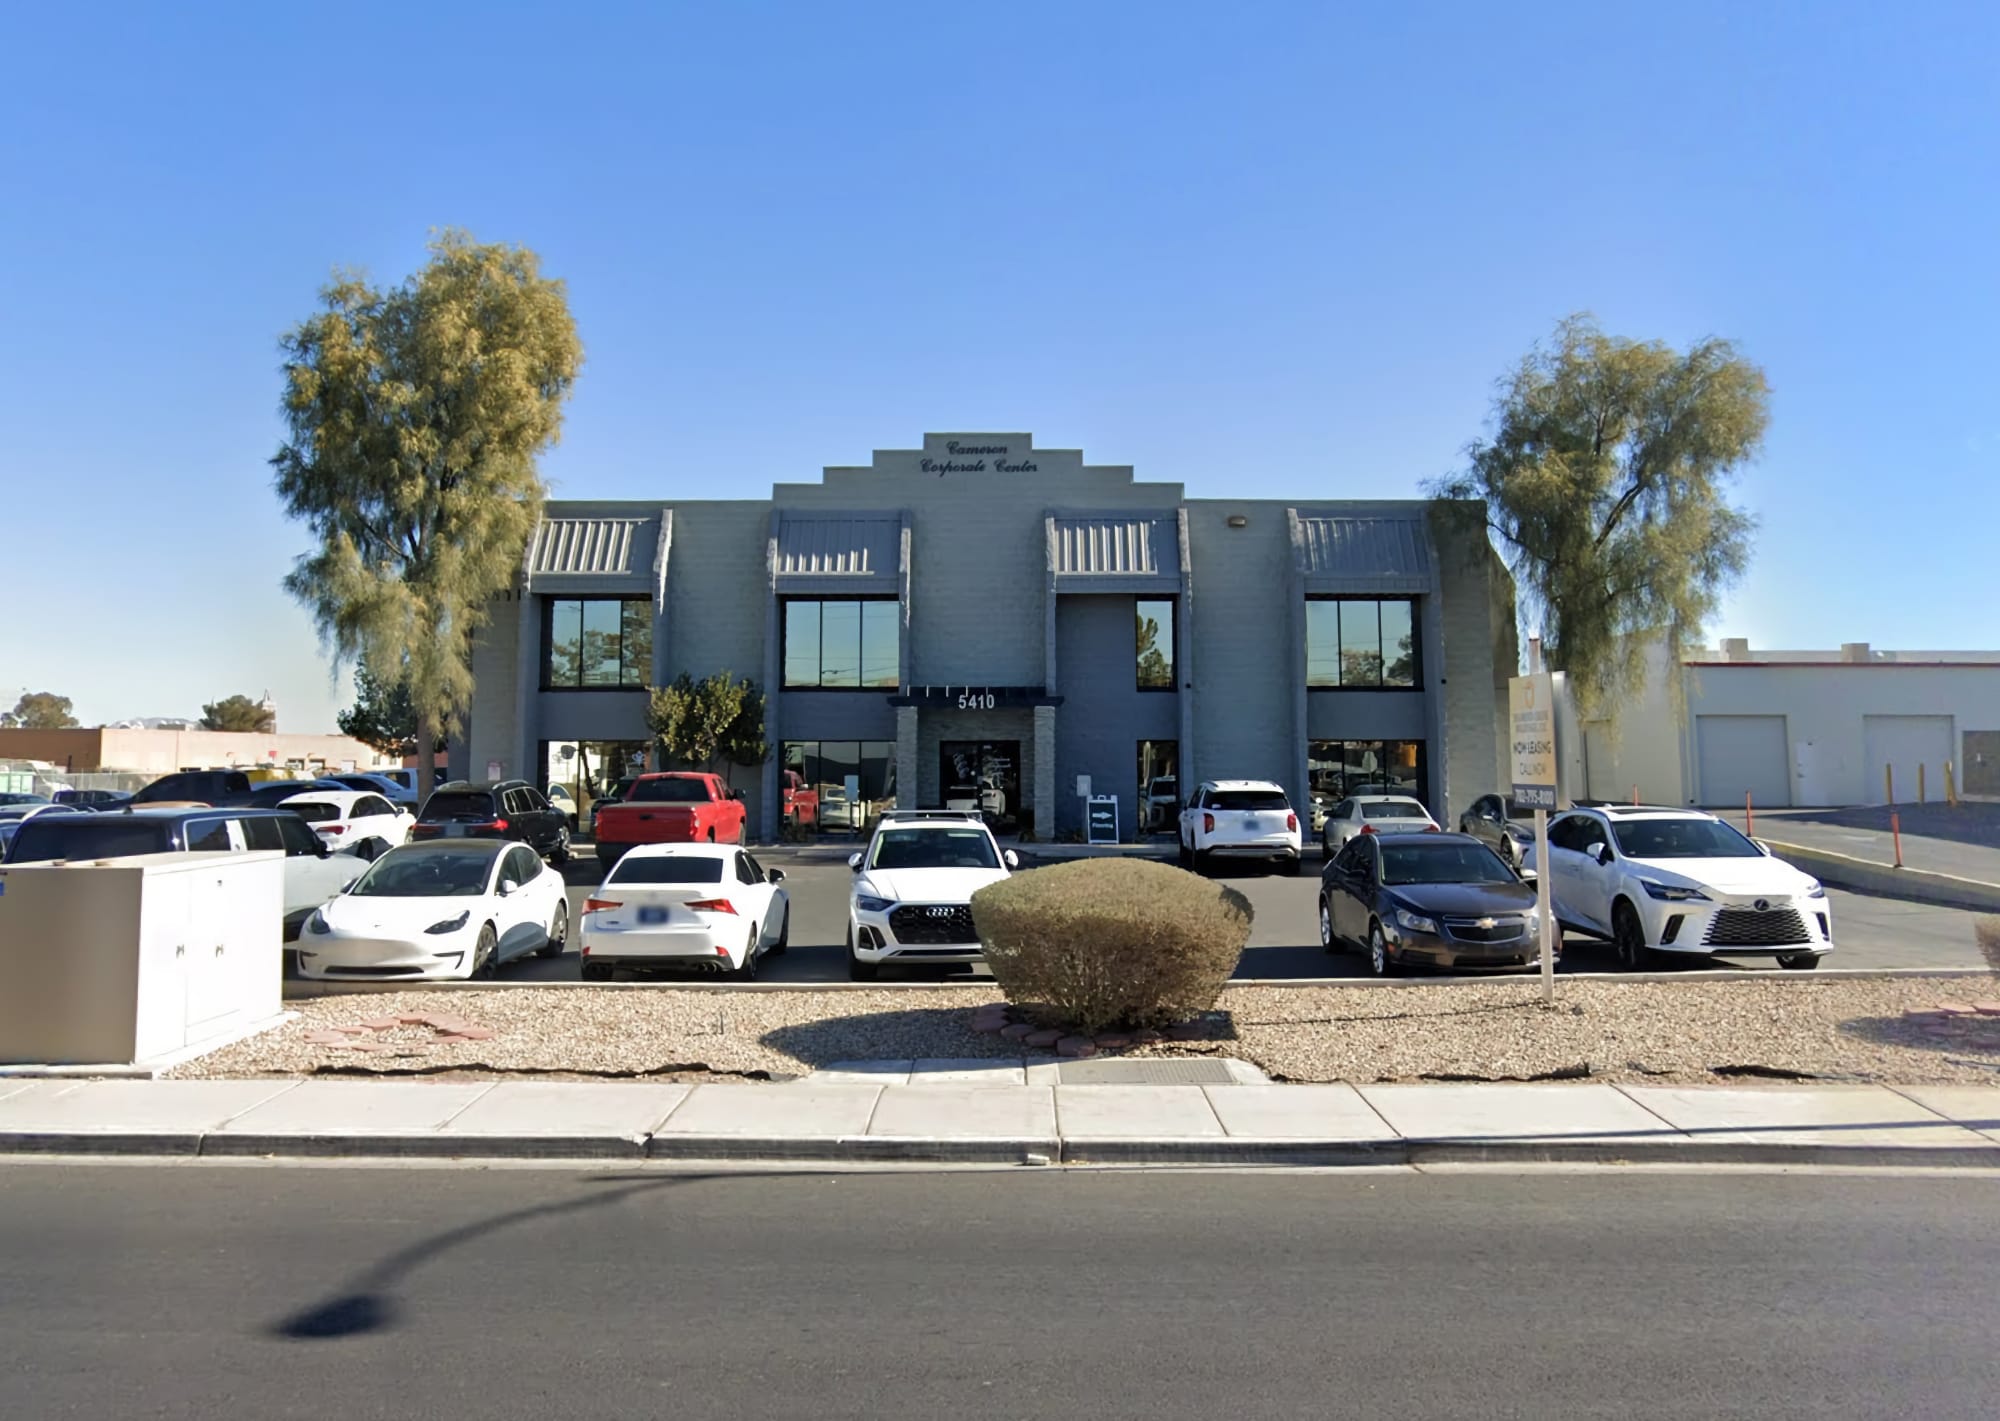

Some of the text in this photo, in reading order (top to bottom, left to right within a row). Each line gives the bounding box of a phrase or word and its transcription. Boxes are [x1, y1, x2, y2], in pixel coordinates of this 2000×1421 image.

[946, 441, 1008, 455] Cameron
[920, 458, 1038, 477] Corporate Center
[958, 694, 995, 709] 5410
